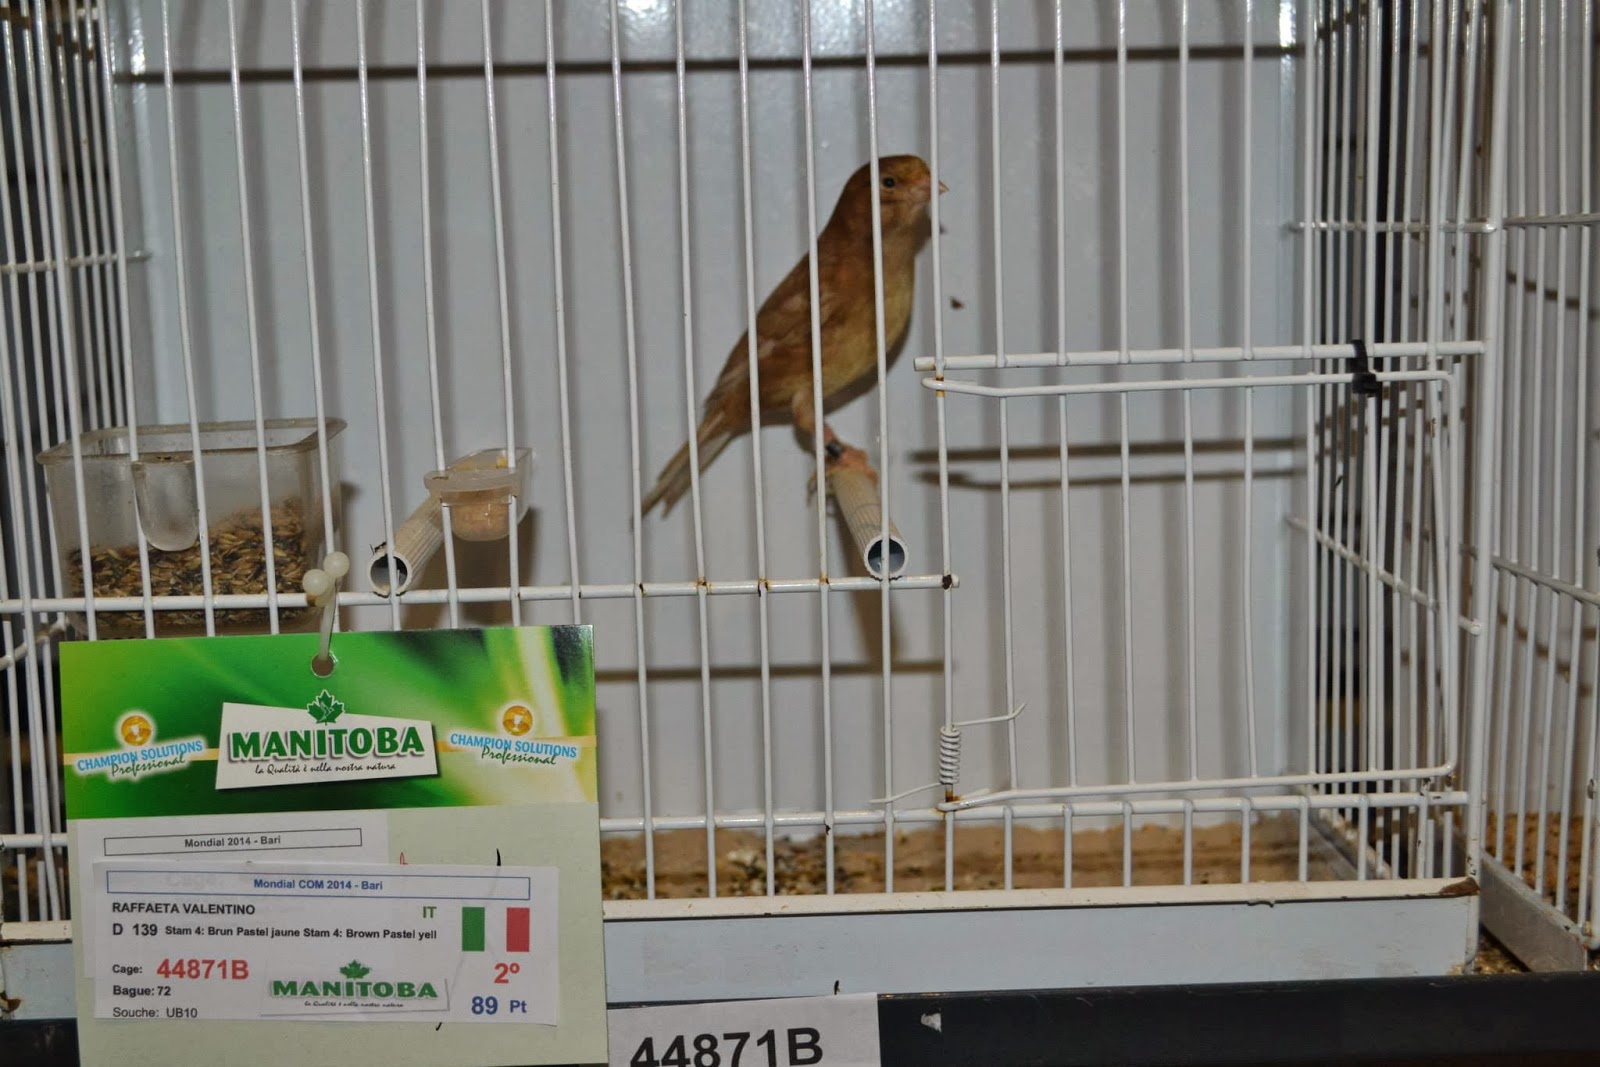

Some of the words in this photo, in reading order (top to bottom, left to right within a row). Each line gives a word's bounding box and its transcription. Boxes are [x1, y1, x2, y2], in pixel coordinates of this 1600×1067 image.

[231, 726, 425, 759] MANITOBA
[450, 732, 512, 751] CHAMPION
[514, 741, 578, 758] SOLUTIONS
[77, 750, 138, 772] CHAMPION
[141, 739, 204, 760] SOLUTIONS
[111, 752, 186, 777] Professional
[481, 745, 557, 766] Professional
[267, 763, 301, 775] Qualità
[310, 762, 332, 772] nella
[335, 763, 363, 772] nostra
[366, 762, 396, 771] natura
[184, 838, 225, 848] Mondial
[227, 836, 251, 847] 2014
[260, 836, 281, 846] Bari
[253, 879, 296, 889] Mondial
[298, 880, 325, 890] COM
[326, 880, 352, 890] 2014
[361, 880, 383, 891] Bari
[112, 902, 180, 914] RAFFAETA
[183, 903, 256, 915] VALENTINO
[422, 906, 437, 918] IT
[112, 923, 123, 936] D
[132, 923, 159, 936] 139
[165, 925, 192, 936] Stam
[195, 926, 205, 936] 4:
[207, 926, 233, 936] Brun
[236, 926, 269, 937] Pastel
[270, 926, 300, 939] jaune
[303, 928, 330, 938] Stam
[332, 929, 342, 938] 4:
[346, 929, 380, 939] Brown
[383, 929, 416, 939] Pastel
[418, 930, 437, 941] yell
[112, 964, 143, 976] Cage:
[156, 958, 250, 980] 44871B
[112, 985, 155, 998] Bague:
[157, 986, 171, 996] 72
[272, 980, 438, 998] MANITOBA
[112, 1007, 160, 1018] Souche:
[166, 1007, 198, 1018] UB10
[471, 995, 498, 1015] 89
[509, 1000, 527, 1014] Pt
[630, 1027, 823, 1067] 44871B
